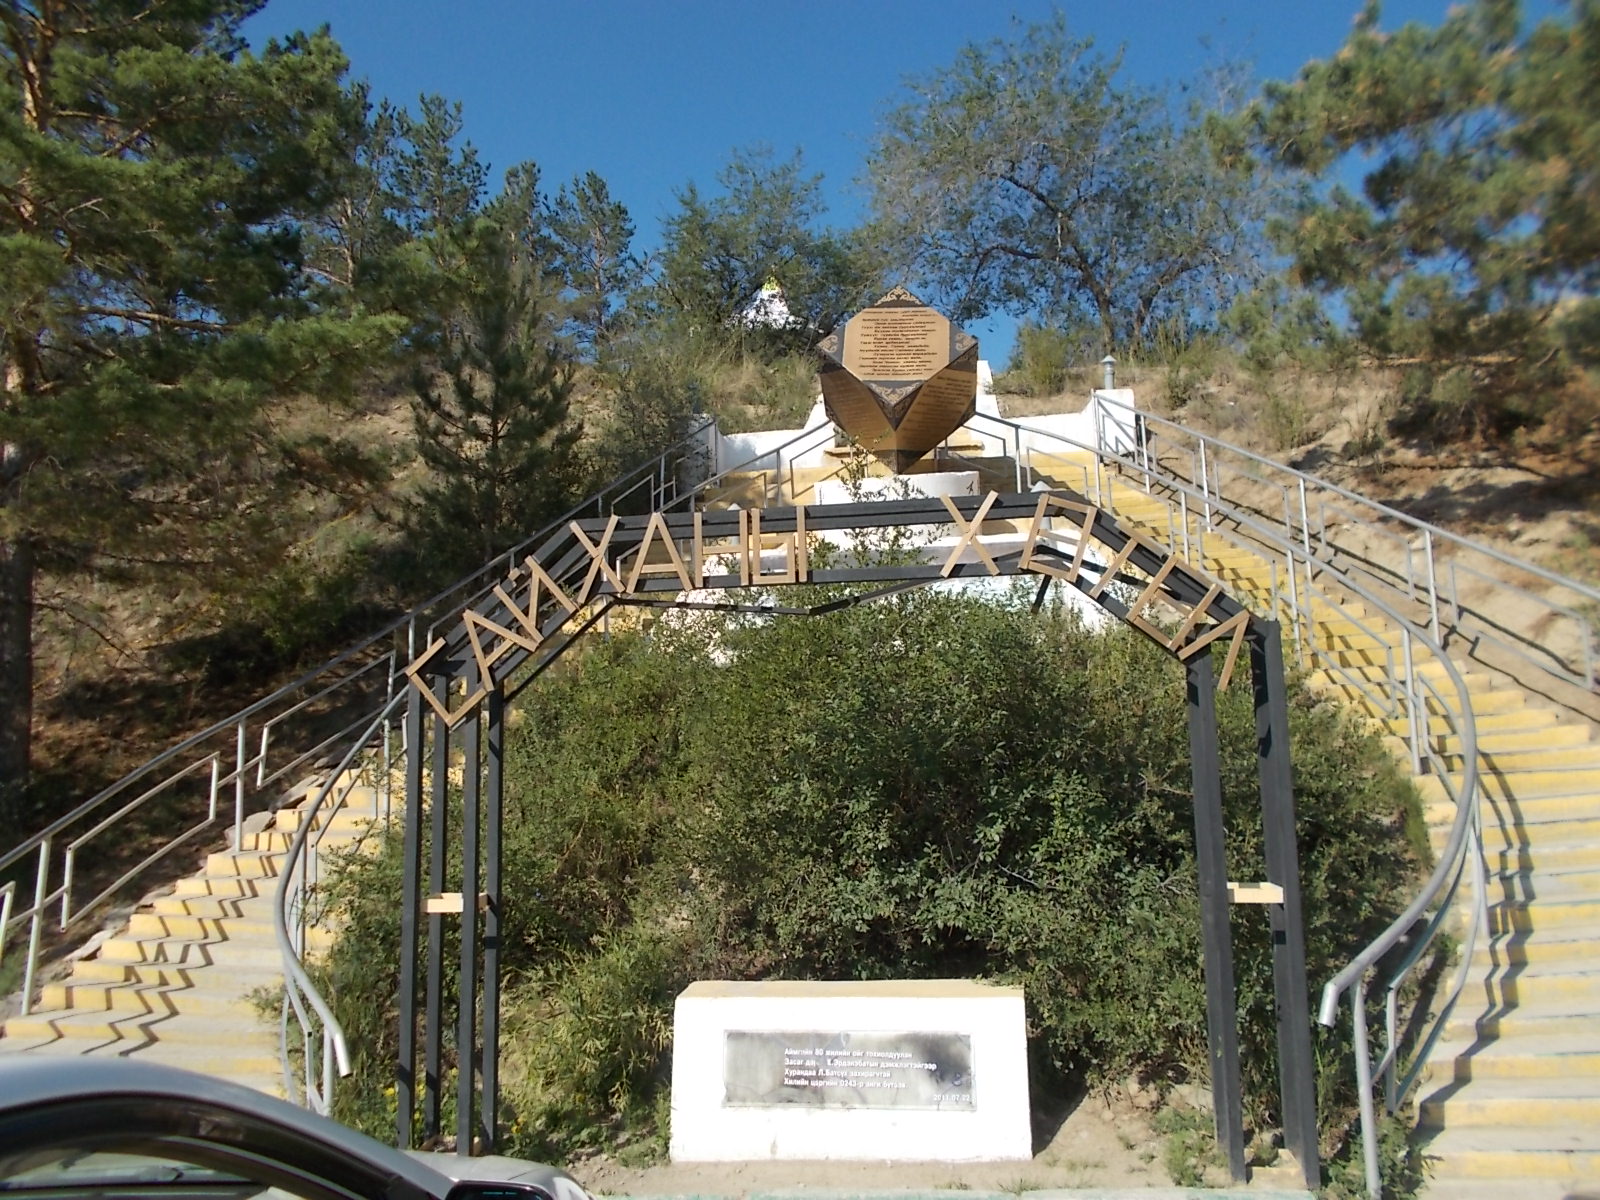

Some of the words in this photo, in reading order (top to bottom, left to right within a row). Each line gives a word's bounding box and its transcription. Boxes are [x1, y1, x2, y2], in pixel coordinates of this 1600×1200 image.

[405, 505, 807, 727] САЙХАНЫ
[940, 490, 1250, 691] ХӨТӨЛ
[815, 1048, 824, 1056] 80
[784, 1058, 803, 1066] Засаг
[784, 1068, 817, 1076] Хурандаа
